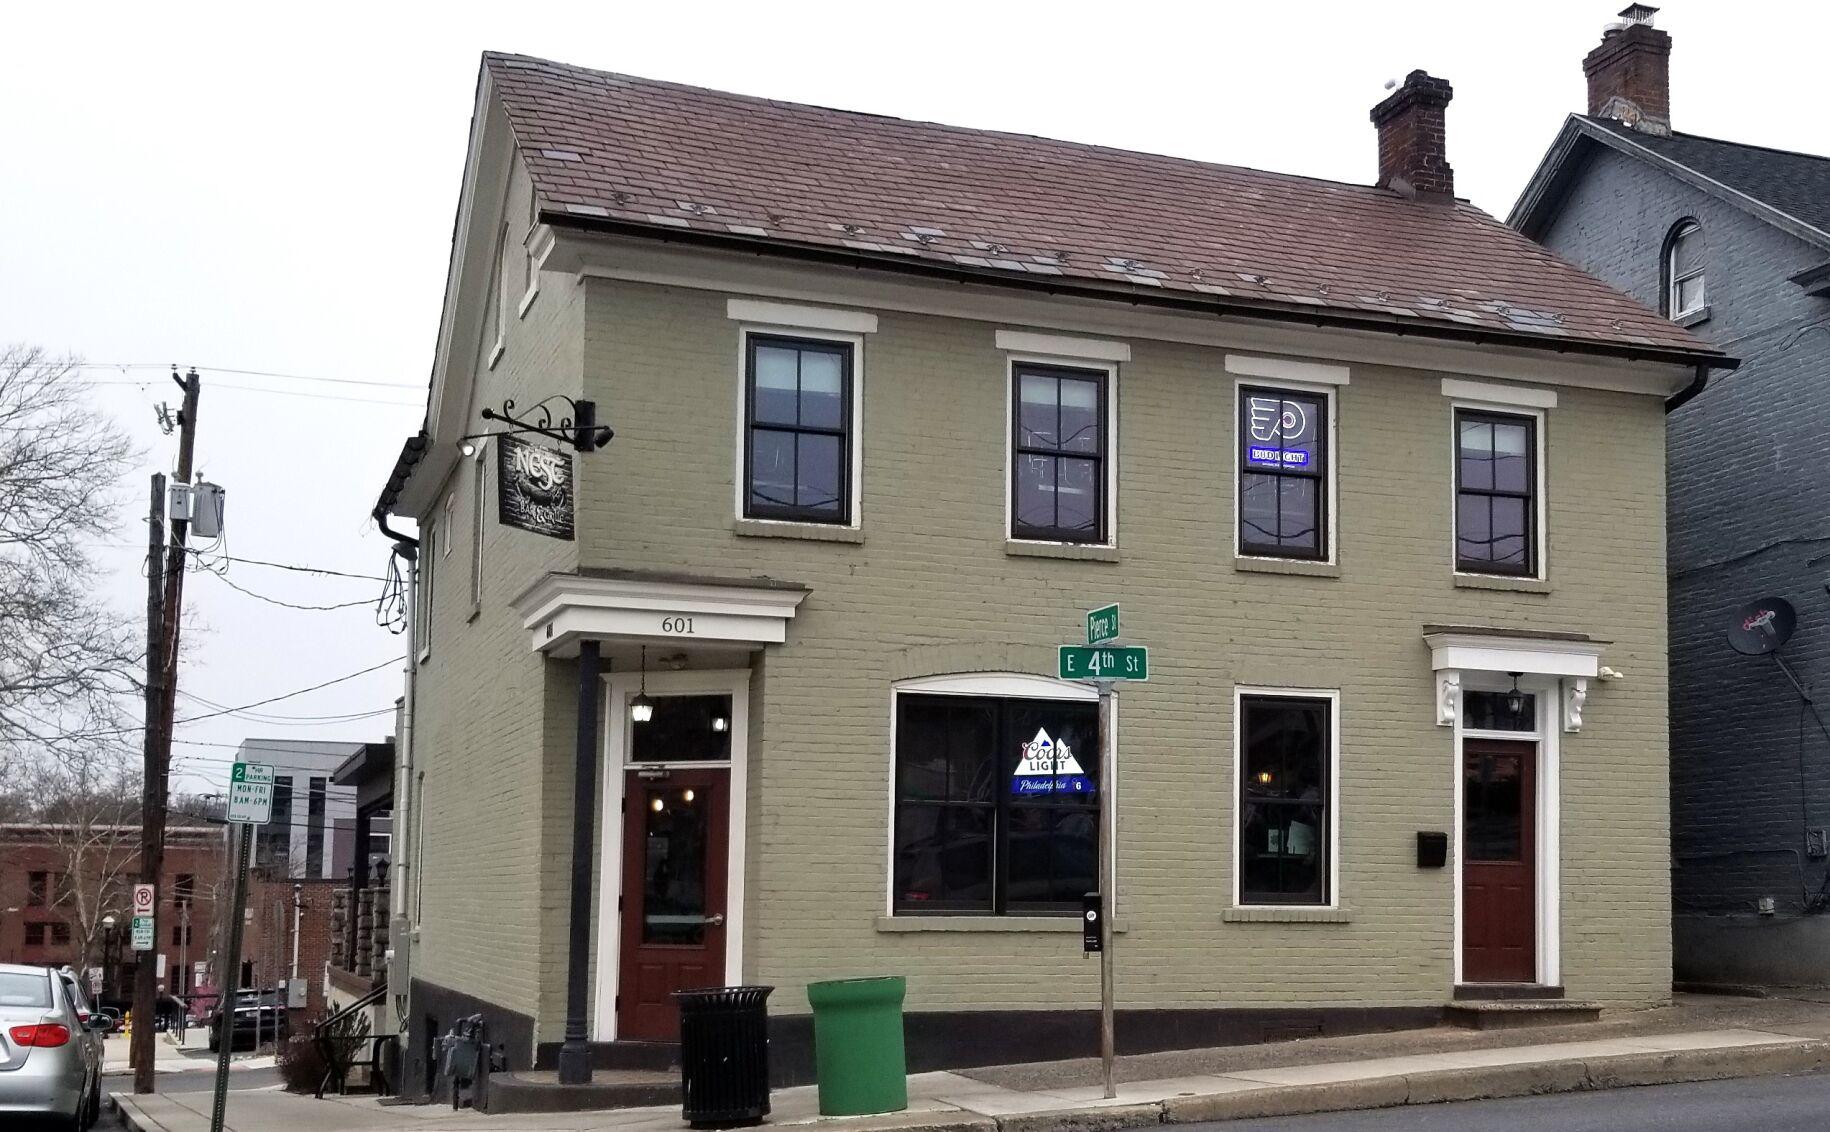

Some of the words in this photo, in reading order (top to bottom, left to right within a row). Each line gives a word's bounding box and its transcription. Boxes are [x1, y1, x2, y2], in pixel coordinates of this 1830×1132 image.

[1275, 451, 1305, 463] LGHT
[536, 505, 546, 523] &
[662, 616, 695, 634] 601
[1090, 616, 1109, 641] Pierce
[1067, 654, 1075, 672] E
[1088, 650, 1115, 676] 4th
[1126, 655, 1139, 672] St
[1021, 741, 1073, 760] Coors
[235, 767, 243, 779] 2
[245, 774, 271, 782] PARKING
